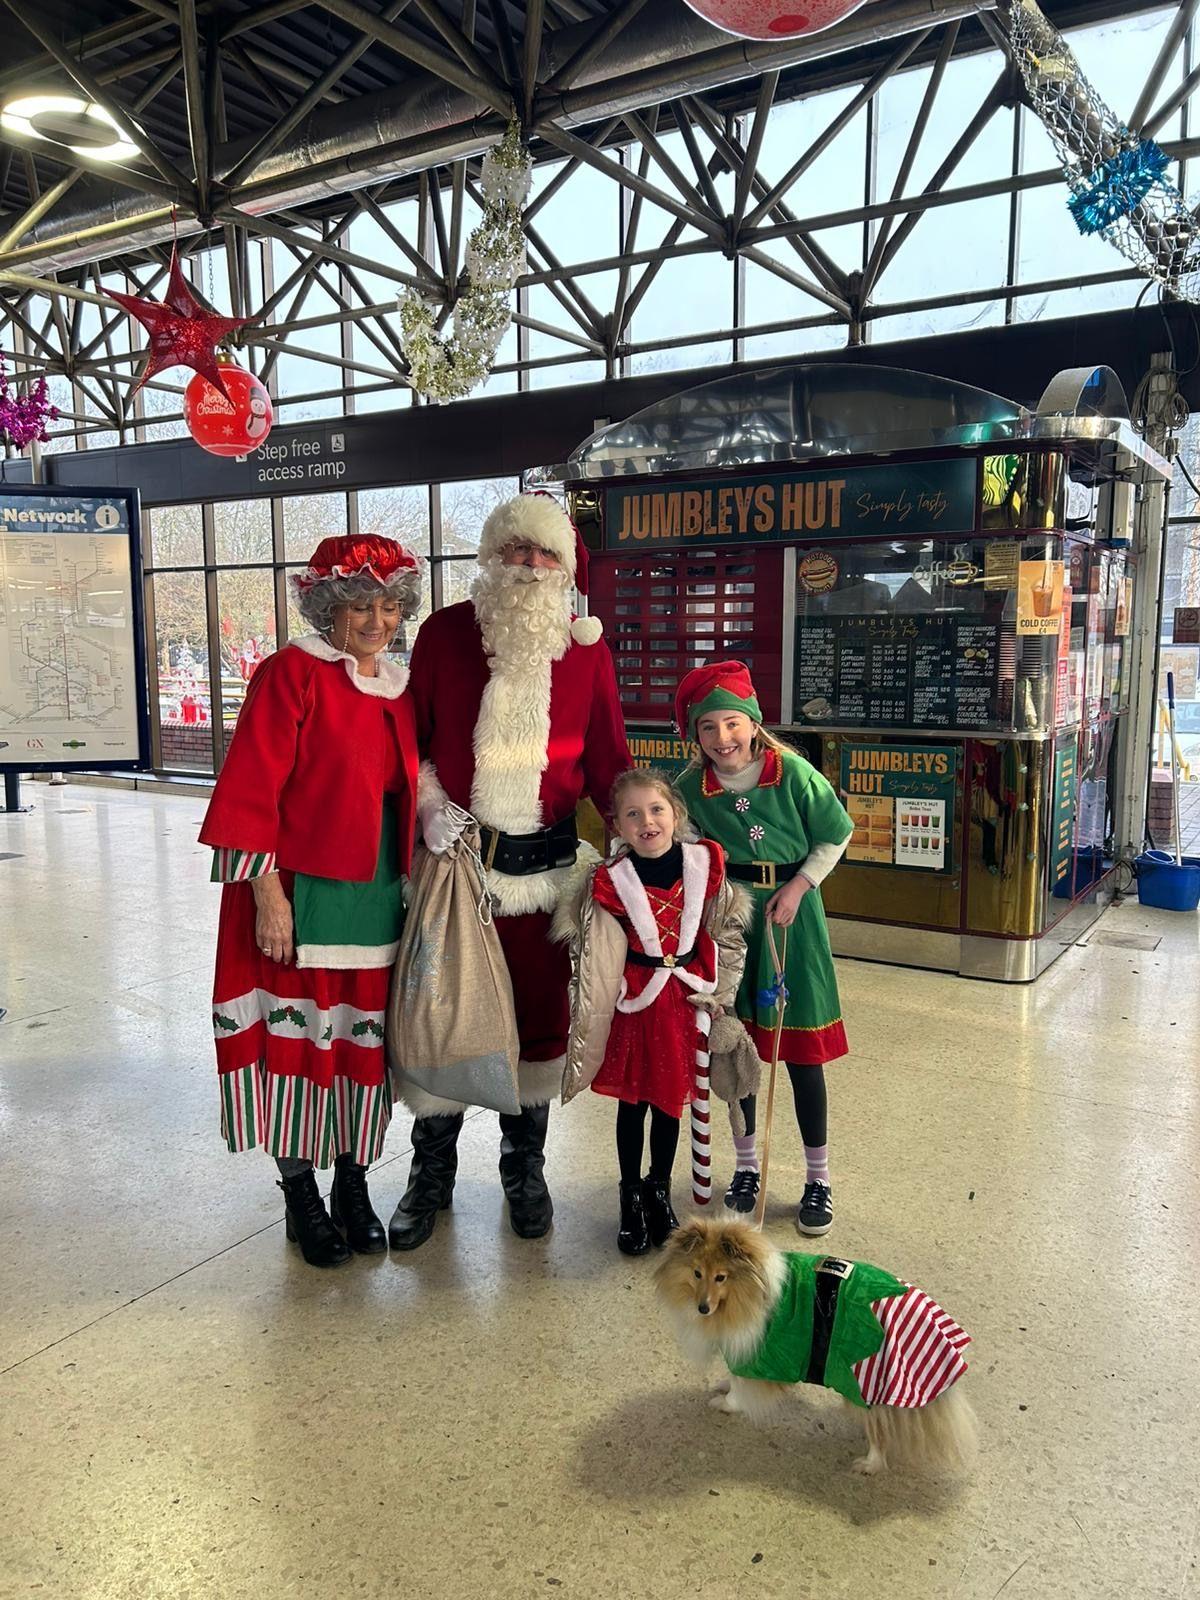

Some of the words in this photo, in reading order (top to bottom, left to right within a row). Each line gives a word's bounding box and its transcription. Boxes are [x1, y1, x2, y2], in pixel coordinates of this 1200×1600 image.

[197, 402, 236, 416] Christmas
[257, 444, 287, 462] Step
[292, 439, 321, 457] free
[258, 465, 304, 481] access
[308, 461, 346, 479] ramp
[3, 508, 87, 524] Network
[618, 484, 775, 541] JUMBLEYS
[781, 480, 846, 531] HUT
[856, 489, 913, 523] Simply
[912, 561, 956, 586] Coffee
[840, 618, 914, 627] JUMBLEYS
[1020, 619, 1041, 628] COLD
[27, 739, 44, 749] GX
[849, 750, 948, 774] JUMBLEYS
[849, 773, 885, 793] HUT
